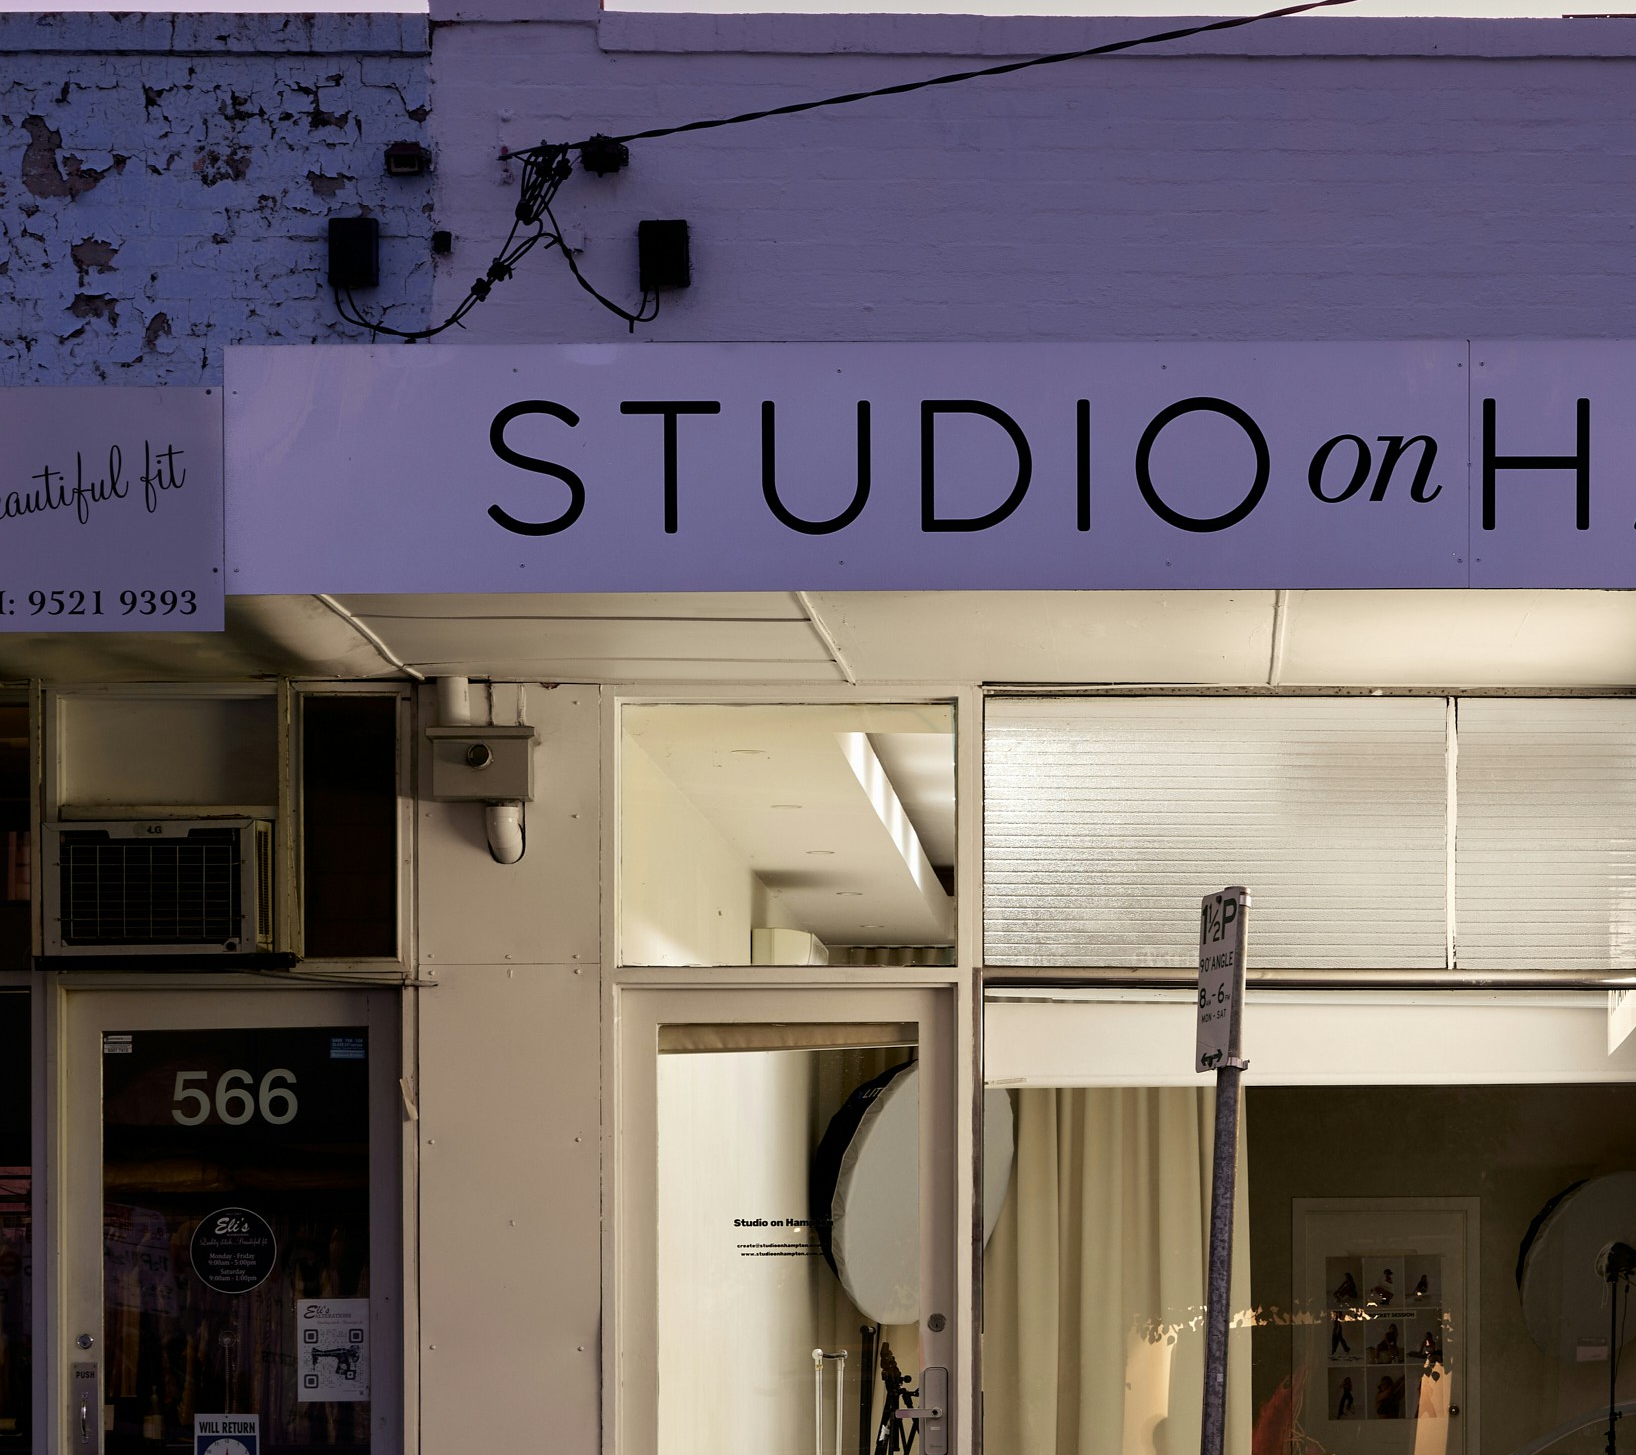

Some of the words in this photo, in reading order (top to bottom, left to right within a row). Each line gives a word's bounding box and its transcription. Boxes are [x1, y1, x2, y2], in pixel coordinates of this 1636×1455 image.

[487, 396, 1271, 537] STUDIO
[1306, 433, 1443, 504] on
[140, 440, 186, 513] fit
[28, 590, 104, 615] 9521
[119, 590, 197, 615] 9393
[149, 825, 162, 834] LG
[1201, 1012, 1212, 1024] MON
[1216, 1008, 1227, 1019] SAT
[172, 1069, 298, 1127] 566
[214, 1216, 250, 1235] Eli's
[734, 1218, 769, 1227] Studio
[209, 1253, 233, 1261] Monday
[236, 1252, 256, 1261] Friday
[234, 1259, 257, 1267] 5:00pm
[220, 1268, 246, 1277] Saturday
[303, 1304, 330, 1319] Eli's
[75, 1369, 95, 1380] PUSH
[199, 1421, 220, 1434] WILL
[222, 1421, 256, 1434] RETURN
